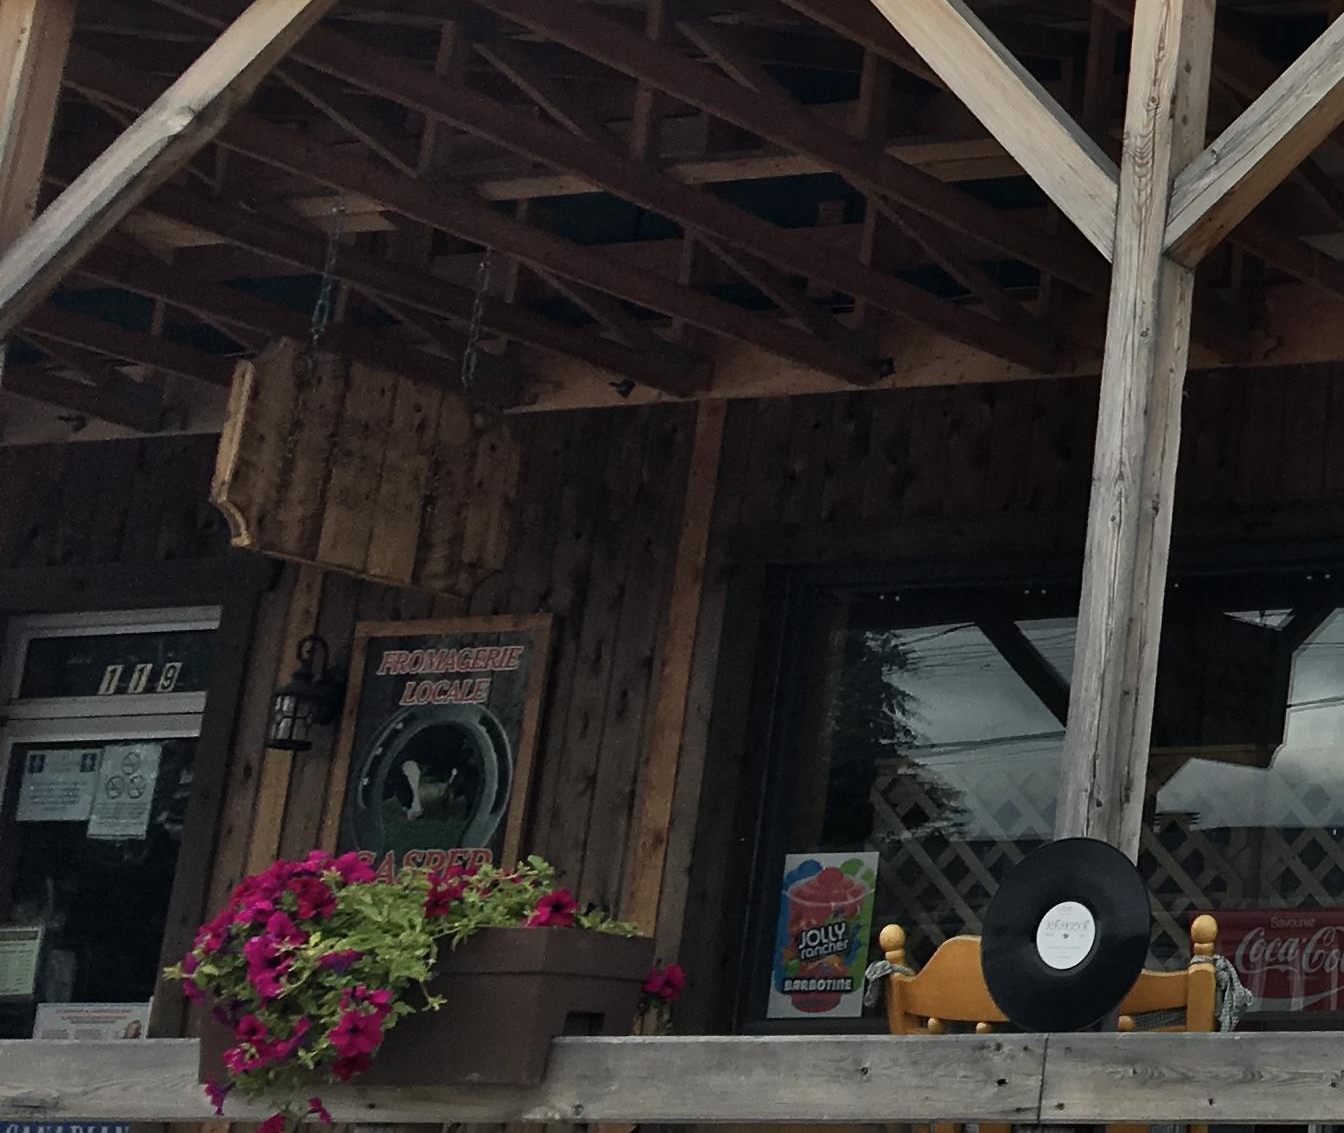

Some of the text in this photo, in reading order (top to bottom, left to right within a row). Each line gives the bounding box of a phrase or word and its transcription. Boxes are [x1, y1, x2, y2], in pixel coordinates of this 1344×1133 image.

[376, 646, 525, 675] FROMAGERIE
[101, 664, 180, 694] 119
[399, 678, 491, 706] LOCALE
[798, 923, 846, 949] JOLLY
[801, 940, 849, 959] rancher
[783, 979, 852, 991] BARBOTINE
